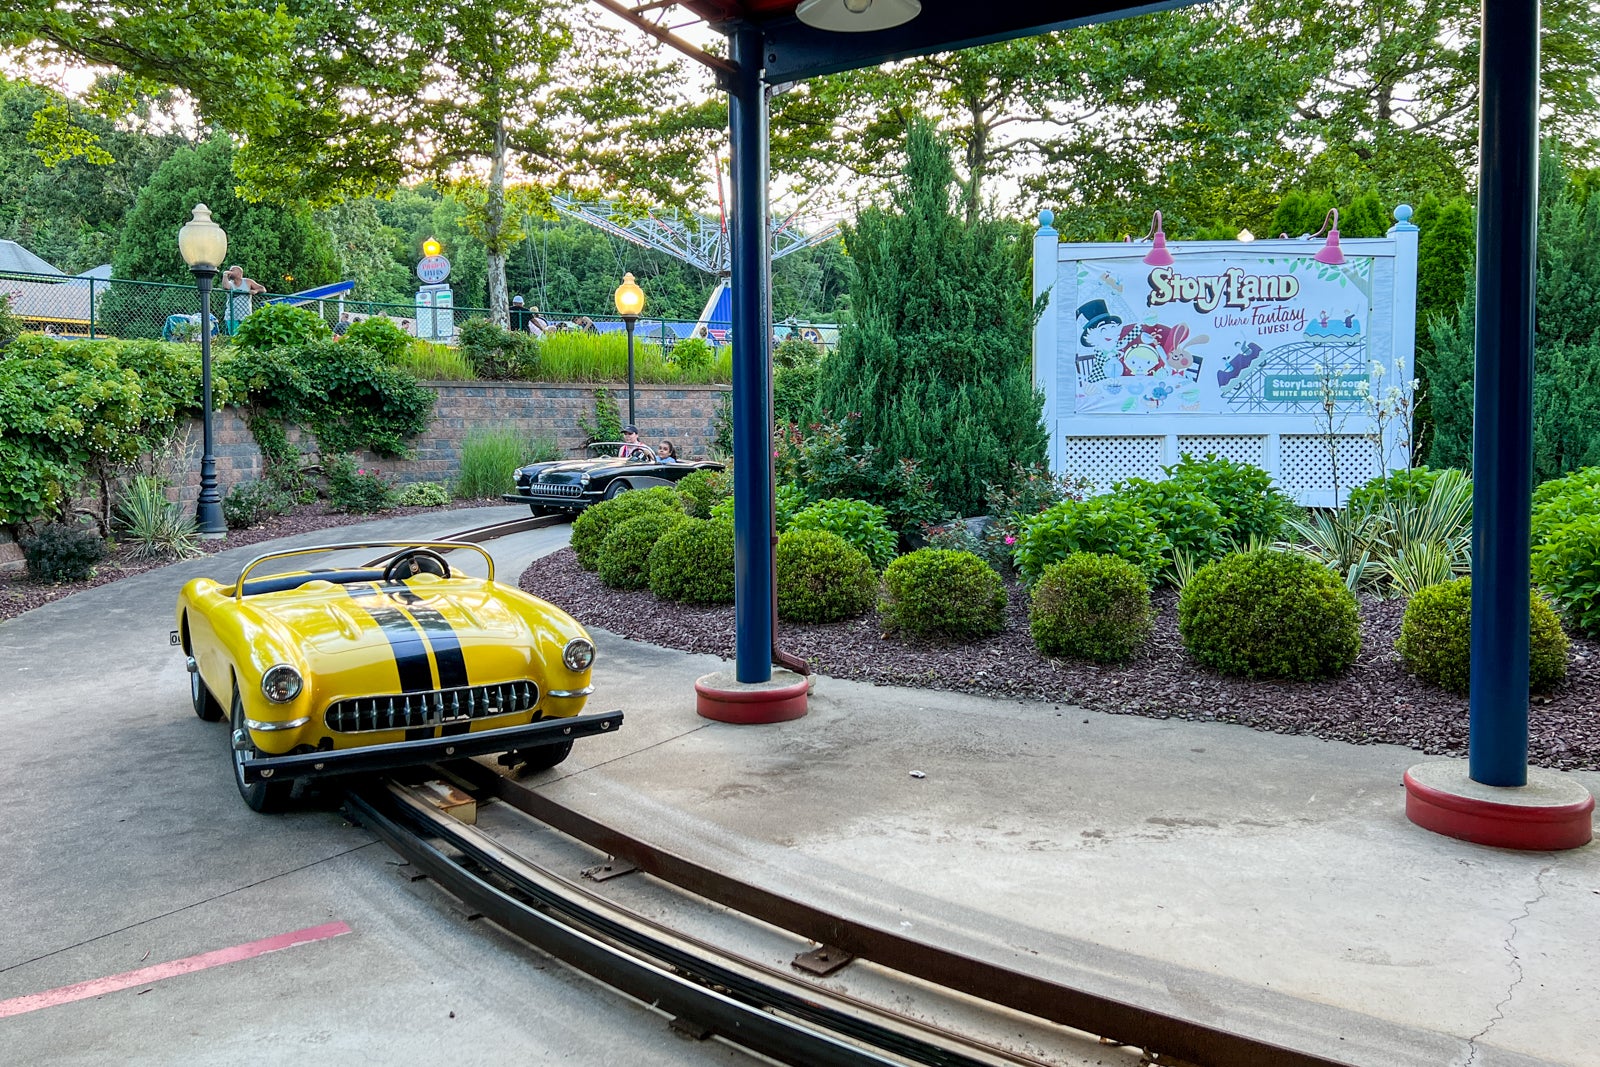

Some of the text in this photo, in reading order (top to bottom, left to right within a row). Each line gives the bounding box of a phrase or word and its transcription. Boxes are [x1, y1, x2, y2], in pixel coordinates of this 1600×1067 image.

[1214, 304, 1309, 332] Where Fantasy
[1258, 323, 1289, 335] LIVES!
[1300, 390, 1352, 398] MOUNAINS,
